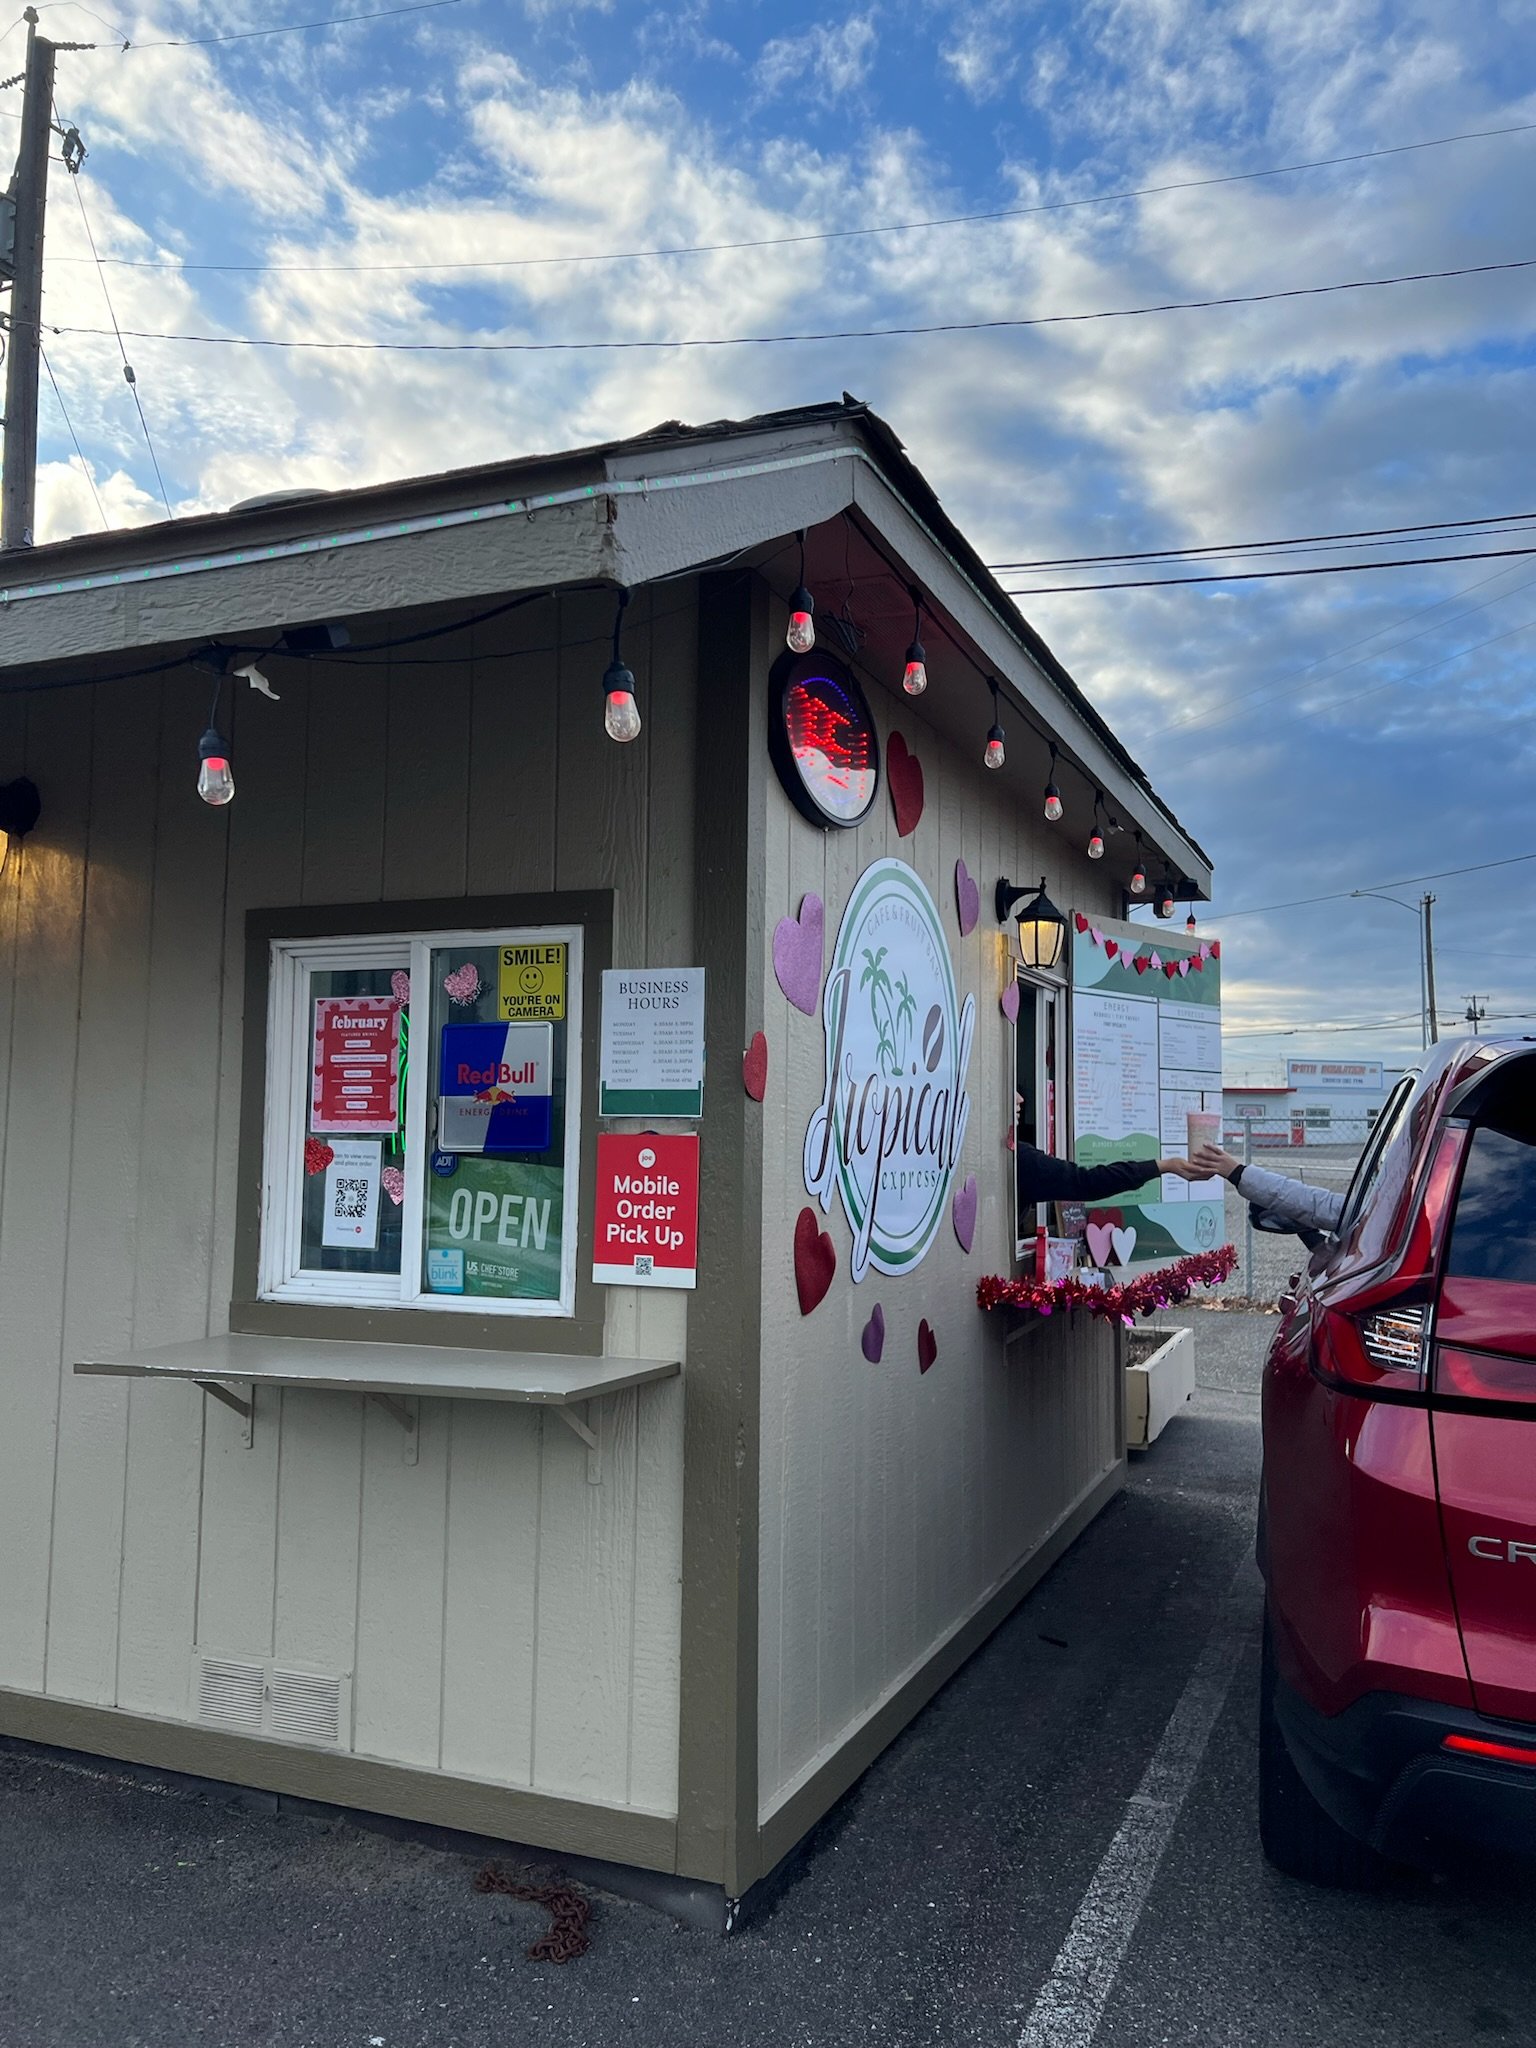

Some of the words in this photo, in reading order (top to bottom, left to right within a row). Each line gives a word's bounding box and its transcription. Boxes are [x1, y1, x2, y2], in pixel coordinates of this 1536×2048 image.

[503, 948, 560, 966] SMILE!
[619, 980, 690, 995] BUSINESS
[502, 995, 542, 1006] YOU'RE
[545, 994, 560, 1005] ON
[628, 996, 680, 1010] HOURS
[508, 1006, 555, 1017] CAMERA
[331, 1015, 389, 1032] february
[808, 969, 975, 1271] Tropical
[435, 1156, 453, 1167] ADT
[641, 1153, 653, 1162] joe
[613, 1175, 680, 1196] Mobile
[881, 1170, 936, 1200] express
[616, 1199, 676, 1220] Order
[449, 1188, 552, 1251] OPEN
[606, 1223, 649, 1244] Pick
[655, 1225, 684, 1250] Up
[431, 1267, 458, 1281] blink
